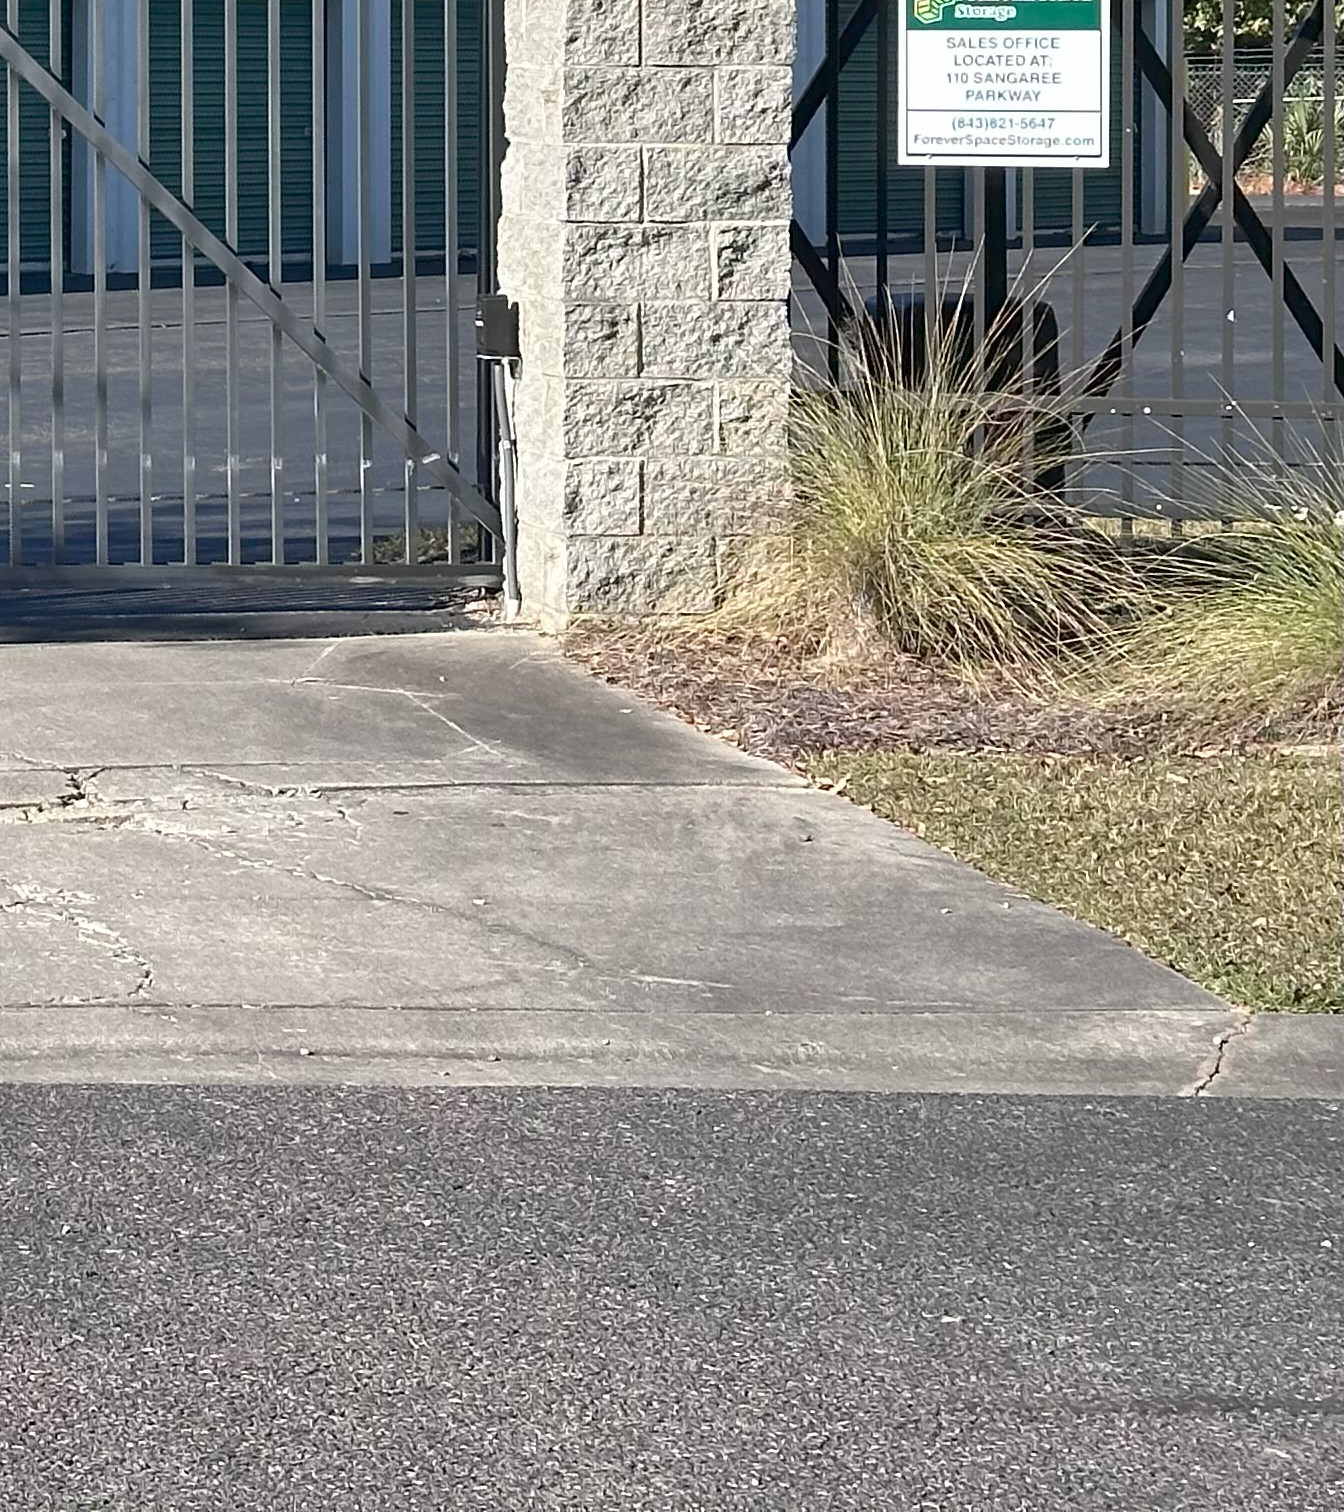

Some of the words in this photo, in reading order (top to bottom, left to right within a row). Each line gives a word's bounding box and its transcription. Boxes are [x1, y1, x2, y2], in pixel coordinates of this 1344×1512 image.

[955, 4, 1017, 21] Storage
[946, 37, 998, 50] SALES
[1003, 37, 1061, 50] OFFICE
[954, 54, 1026, 67] LOCATED
[1029, 54, 1053, 68] AT:
[947, 72, 969, 84] 110
[973, 72, 1062, 85] SANGAREE
[965, 89, 1042, 102] PARKWAY
[951, 117, 1056, 131] (843)821-5647
[913, 134, 1095, 149] ForeverSpaceStorage.com
